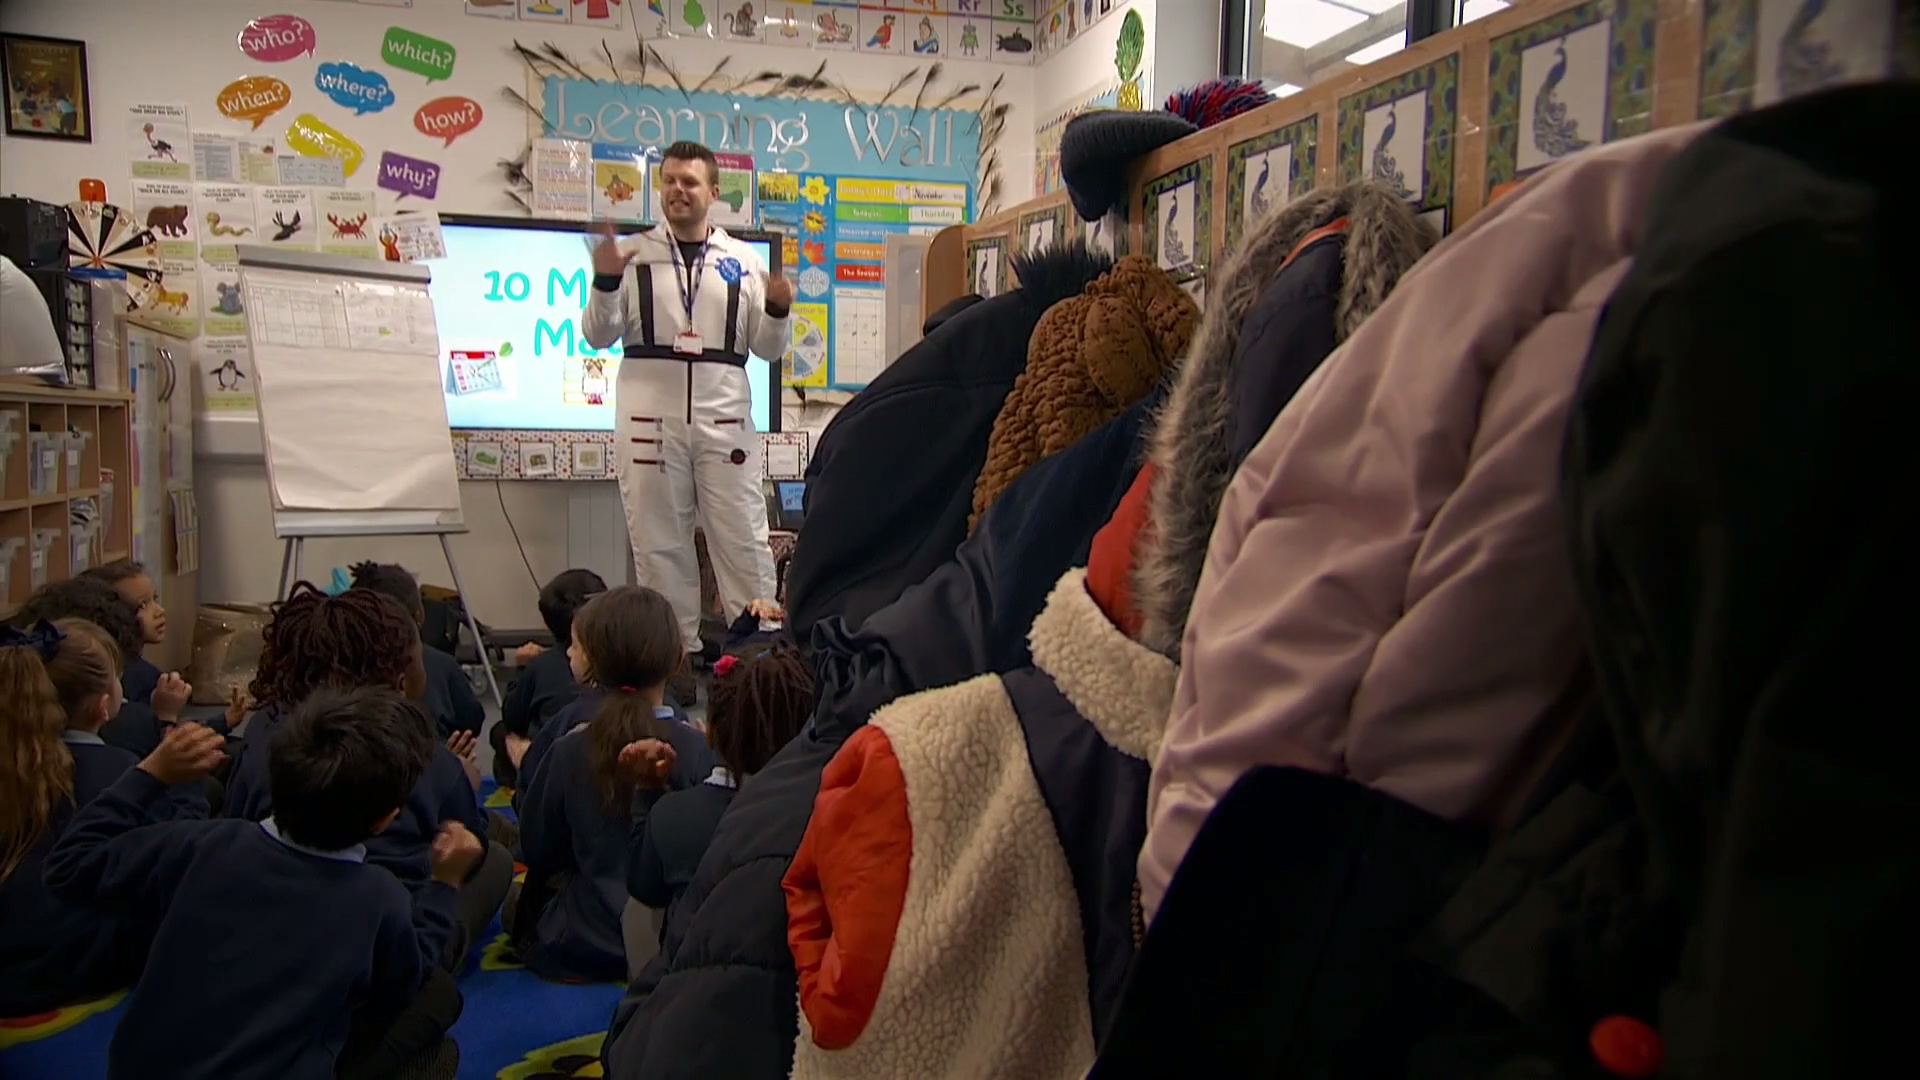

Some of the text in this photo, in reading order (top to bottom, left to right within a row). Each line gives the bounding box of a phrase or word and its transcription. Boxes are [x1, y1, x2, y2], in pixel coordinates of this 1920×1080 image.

[247, 19, 304, 53] who?
[387, 39, 453, 70] which?
[221, 81, 285, 114] when?
[319, 71, 388, 103] where?
[419, 102, 476, 132] how?
[556, 83, 952, 170] Learning Wall
[385, 162, 436, 189] why?
[921, 209, 955, 220] Thursday
[483, 270, 530, 302] 10
[843, 268, 879, 278] The Season
